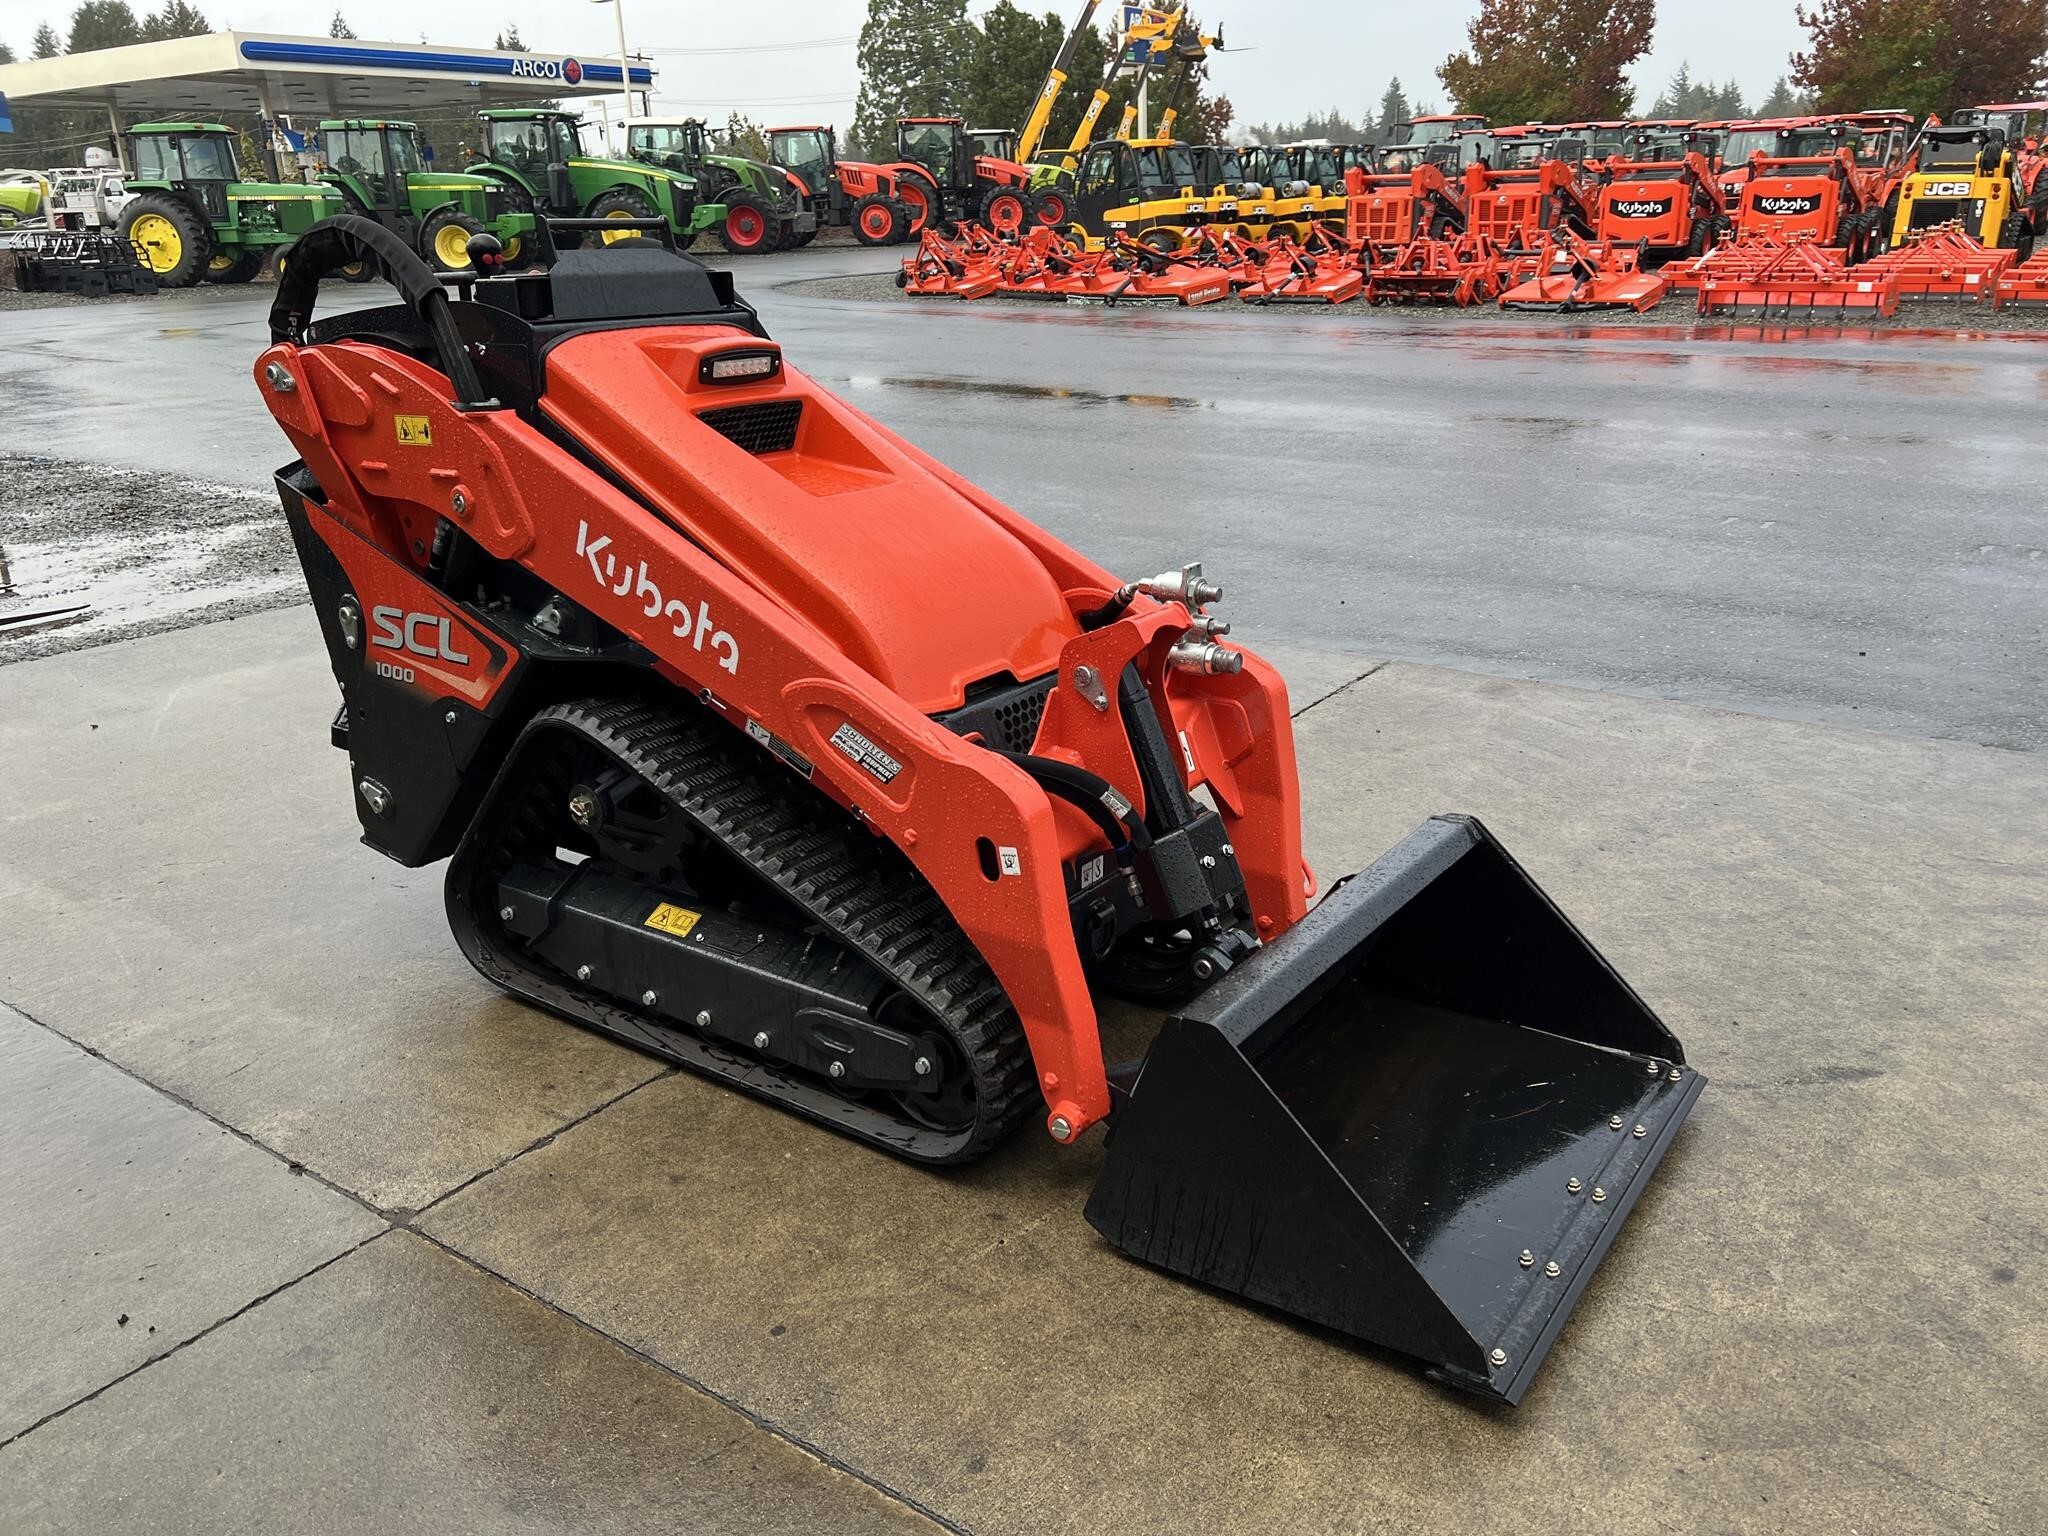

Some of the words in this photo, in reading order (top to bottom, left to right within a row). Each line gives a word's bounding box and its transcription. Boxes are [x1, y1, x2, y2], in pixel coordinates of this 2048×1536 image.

[512, 59, 557, 78] ARCO
[1042, 77, 1058, 100] JCB
[1086, 100, 1101, 122] JCB
[1923, 182, 1971, 196] JCB
[1186, 203, 1204, 213] JCB
[1219, 201, 1237, 211] JCB
[1300, 203, 1314, 212] JCB
[1617, 201, 1663, 214] Kubota
[1761, 198, 1811, 210] Kubota
[575, 519, 739, 676] Kubota
[372, 605, 469, 665] SCL
[376, 661, 415, 684] 1000
[841, 725, 901, 773] SCHOLTEN'S
[863, 753, 894, 779] EQUIPMENT
